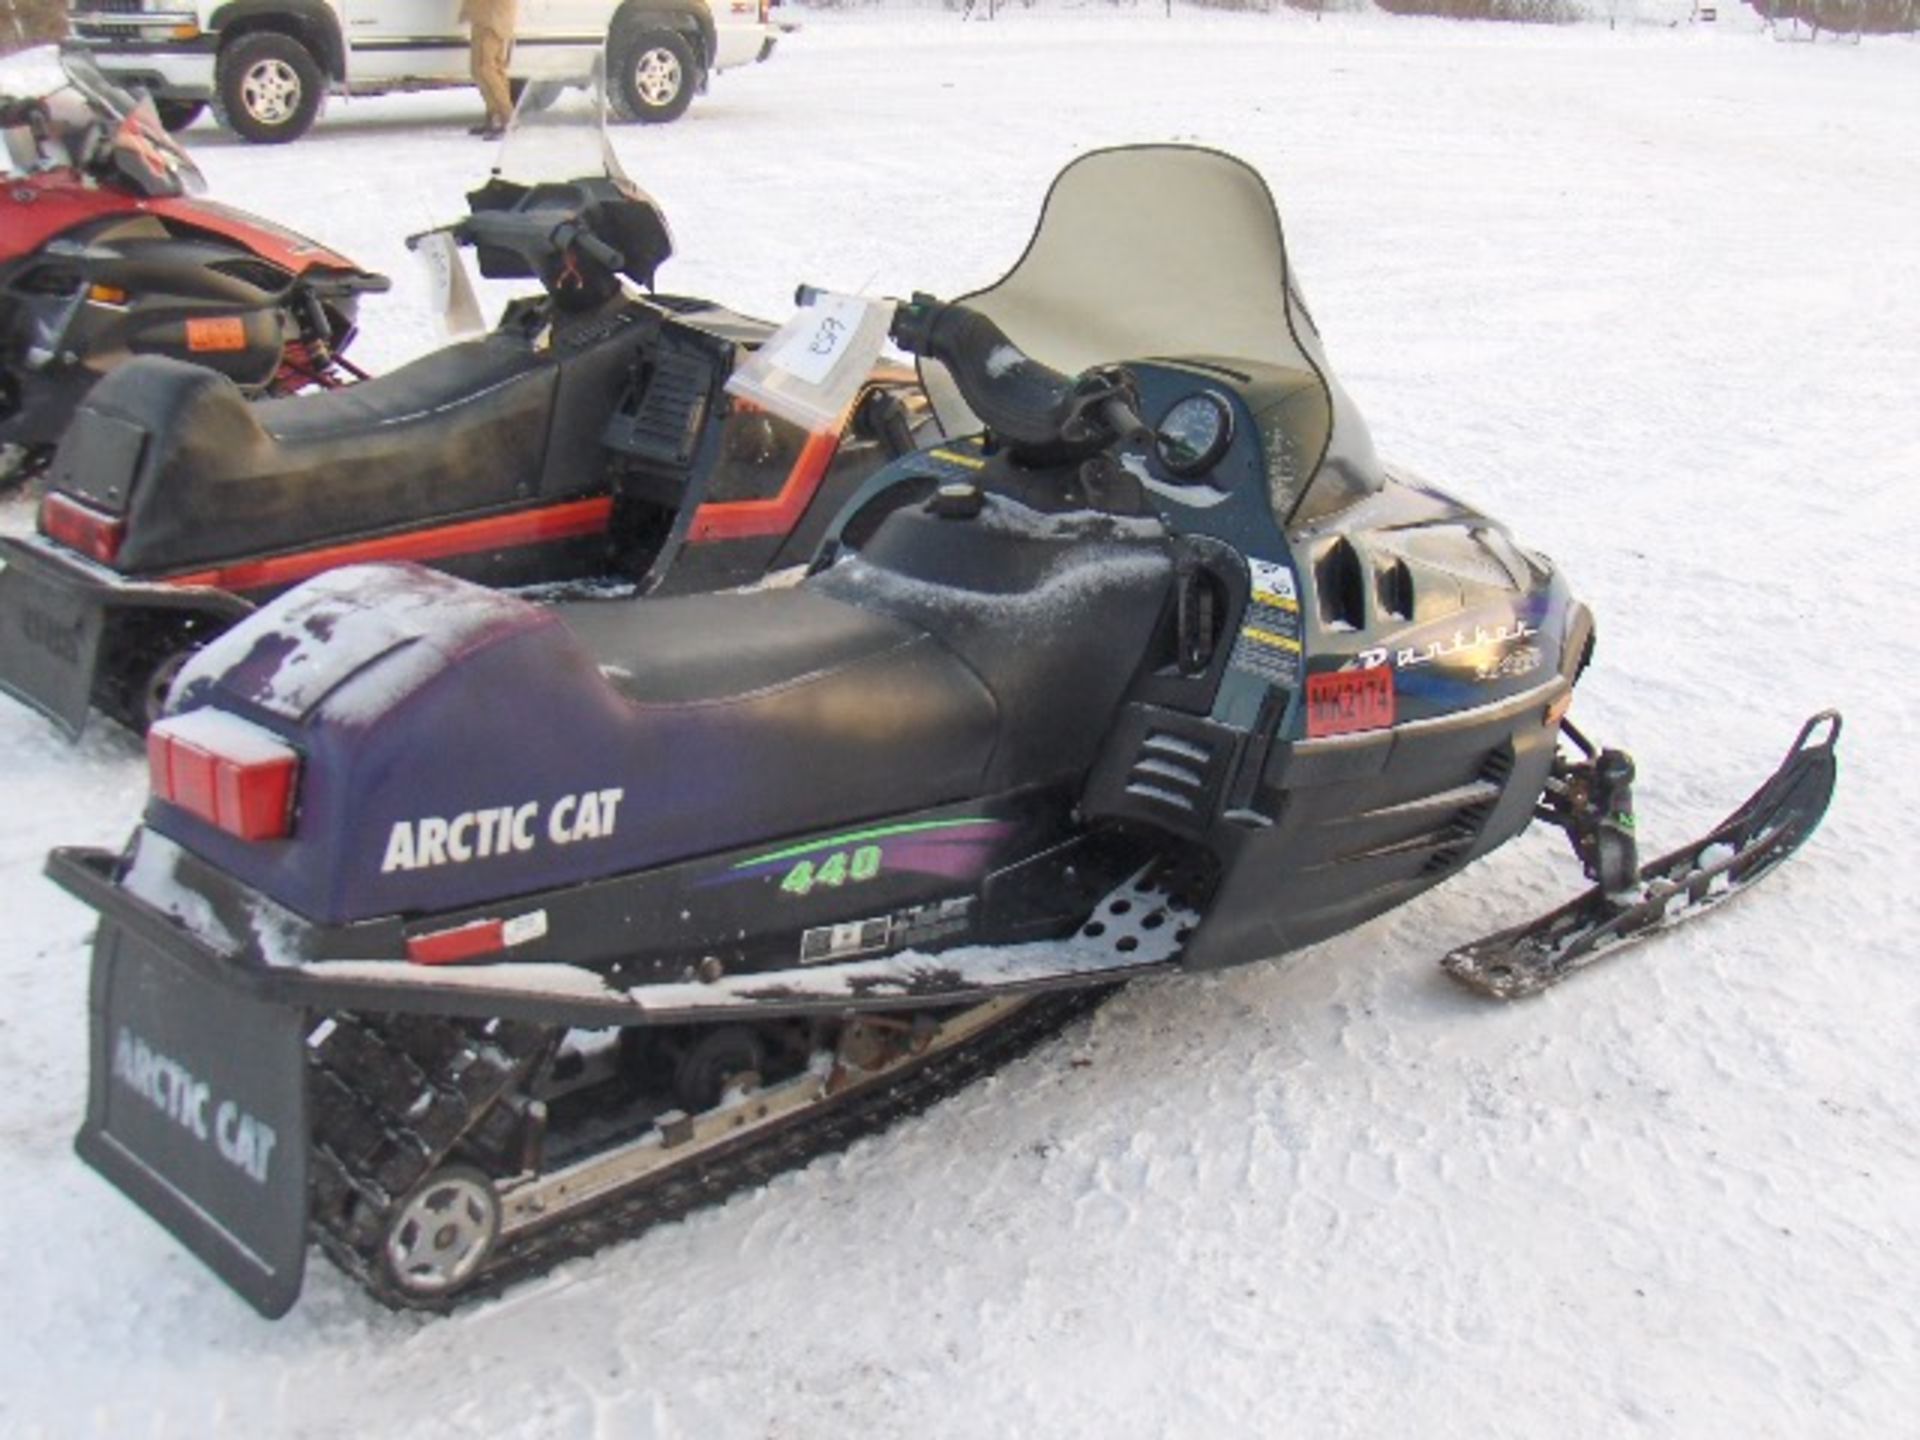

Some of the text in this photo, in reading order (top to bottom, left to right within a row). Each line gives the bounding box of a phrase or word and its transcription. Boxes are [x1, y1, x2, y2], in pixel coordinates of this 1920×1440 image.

[1357, 620, 1537, 669] Panther
[1311, 680, 1388, 722] MK2174
[381, 788, 624, 873] ARCTIC CAT
[780, 845, 882, 894] 440
[112, 1025, 276, 1182] ARCTIC CAT
